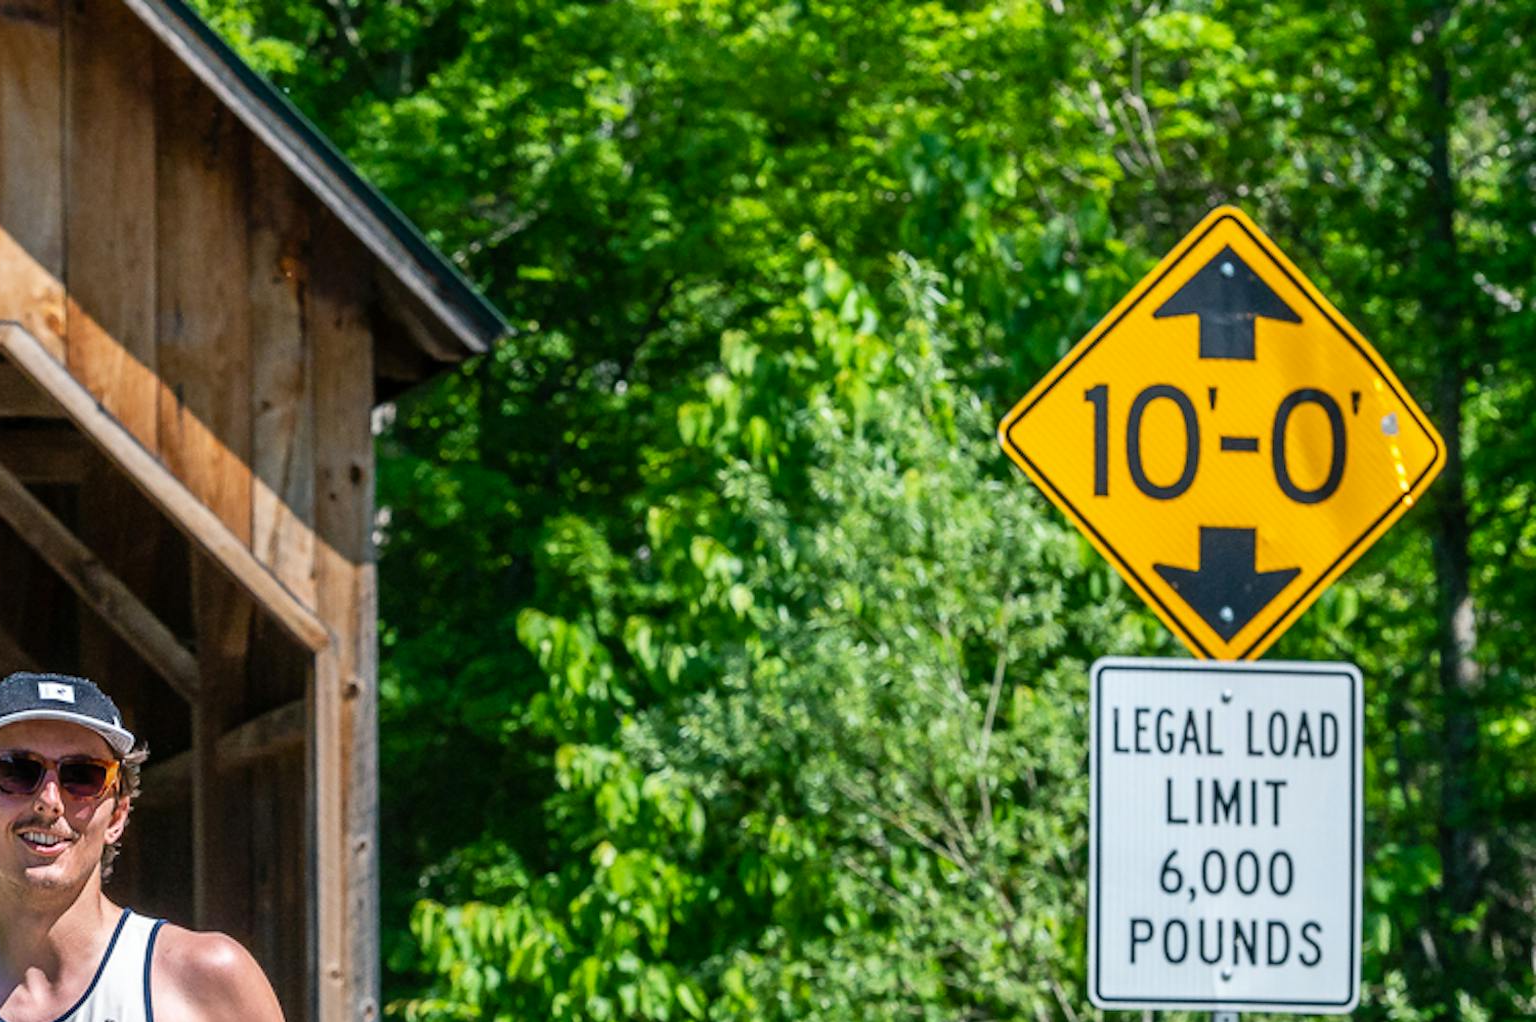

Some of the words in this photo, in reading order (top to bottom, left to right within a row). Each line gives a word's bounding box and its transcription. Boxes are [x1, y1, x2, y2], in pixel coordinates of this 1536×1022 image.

[1084, 383, 1361, 505] 10'-0'
[1113, 707, 1224, 755] LEGAL
[1247, 709, 1340, 759] LOAD
[1166, 777, 1287, 827] LIMIT
[1159, 849, 1295, 903] 6,000
[1129, 918, 1323, 968] POUNDS
